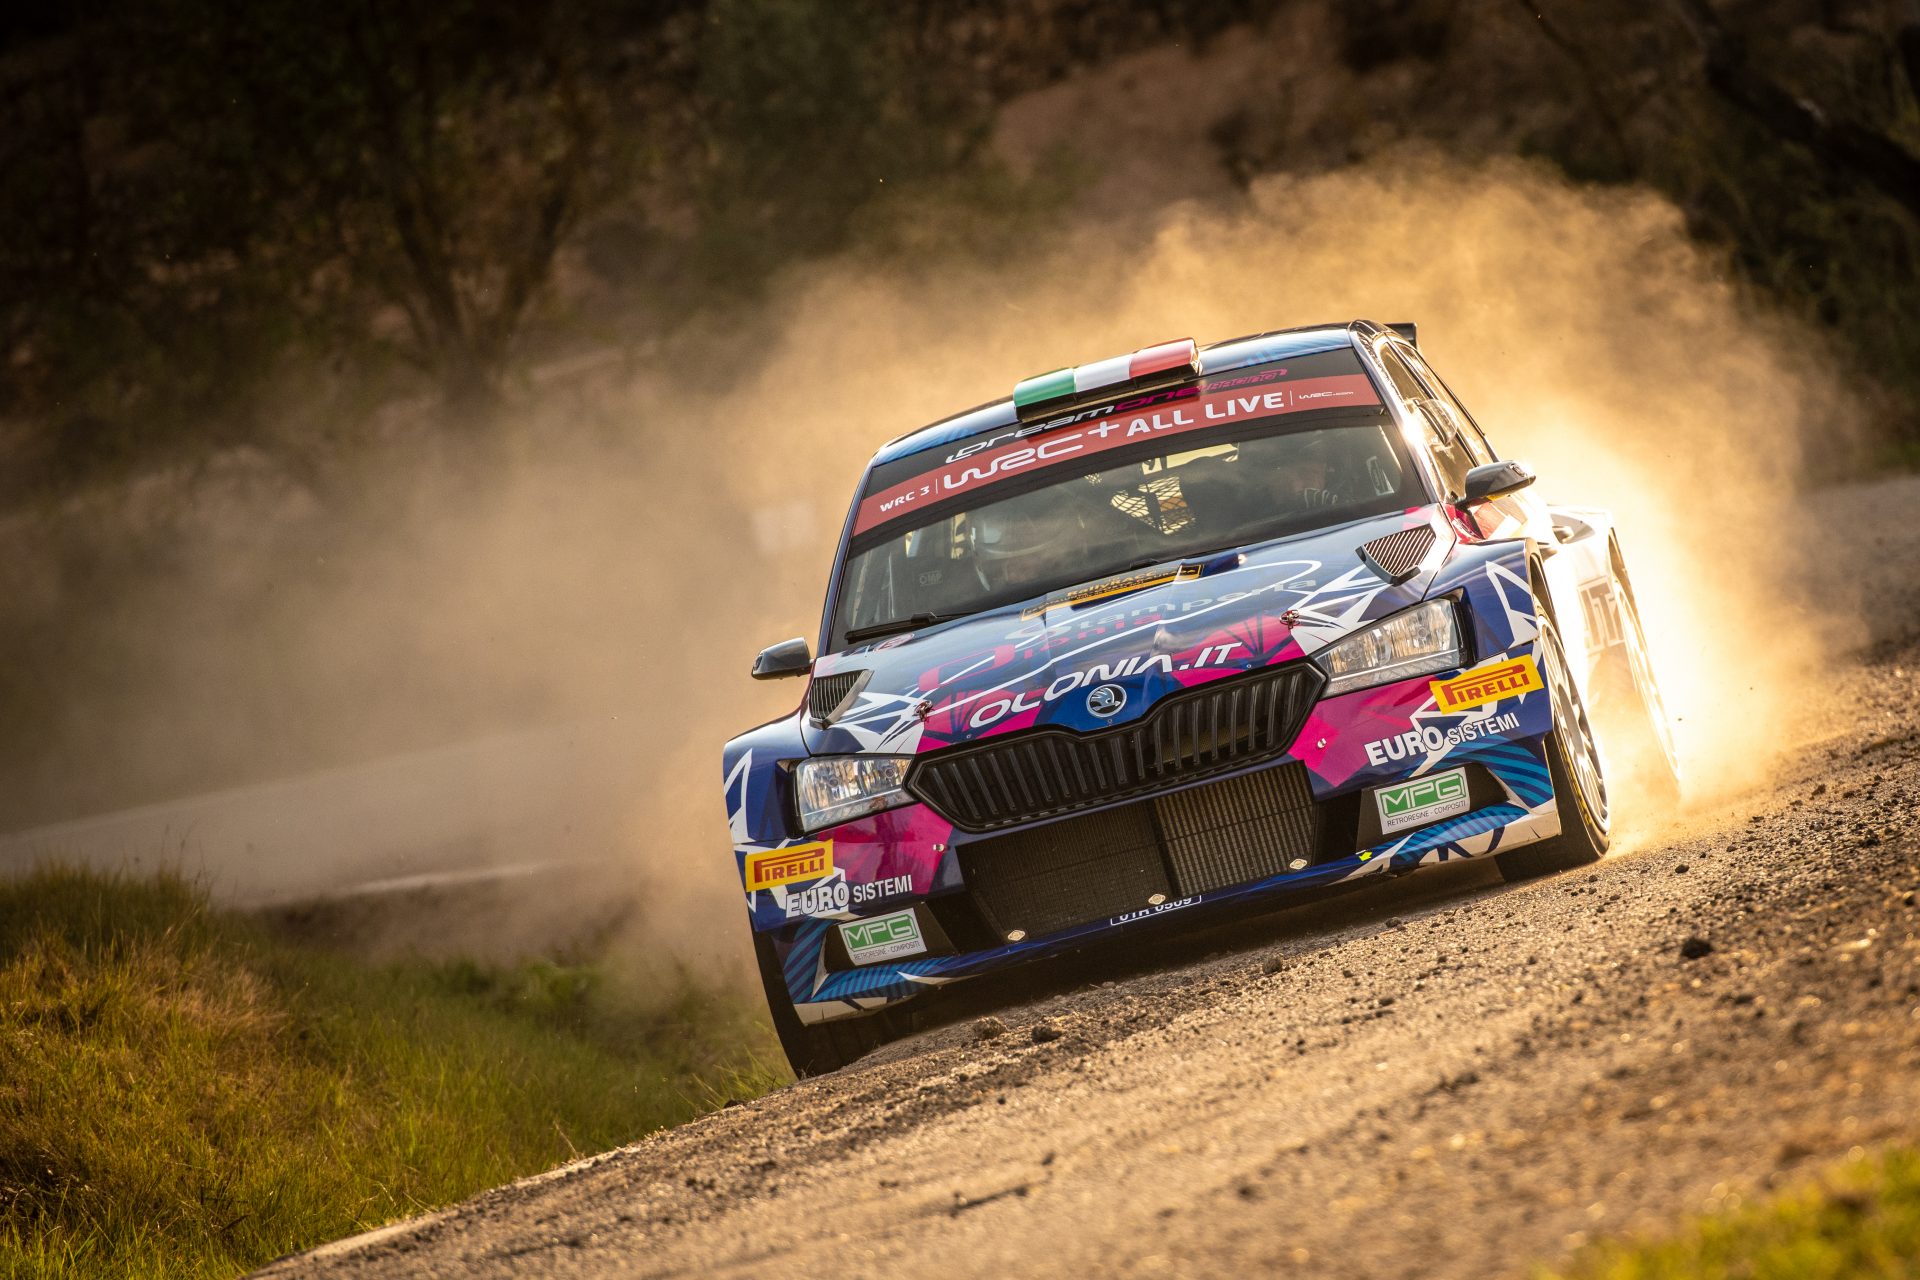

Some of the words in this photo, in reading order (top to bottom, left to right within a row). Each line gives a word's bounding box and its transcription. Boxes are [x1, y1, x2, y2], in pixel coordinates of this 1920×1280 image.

[1126, 409, 1194, 437] ALL
[1205, 391, 1285, 419] LIVE
[880, 491, 915, 512] WRC
[920, 485, 930, 496] 3
[969, 642, 1243, 729] OLONIA.IT
[1441, 664, 1530, 705] PIRELLI
[1364, 726, 1445, 767] EURO
[1447, 712, 1520, 746] SISTEMI
[1381, 774, 1464, 814] MPG
[1386, 810, 1429, 827] RETRORESINE
[1434, 800, 1466, 815] COMPOSITI
[754, 847, 825, 884] PIRELLI
[786, 881, 849, 918] EURO
[853, 874, 913, 903] SISTEMI
[844, 915, 914, 949] MPG
